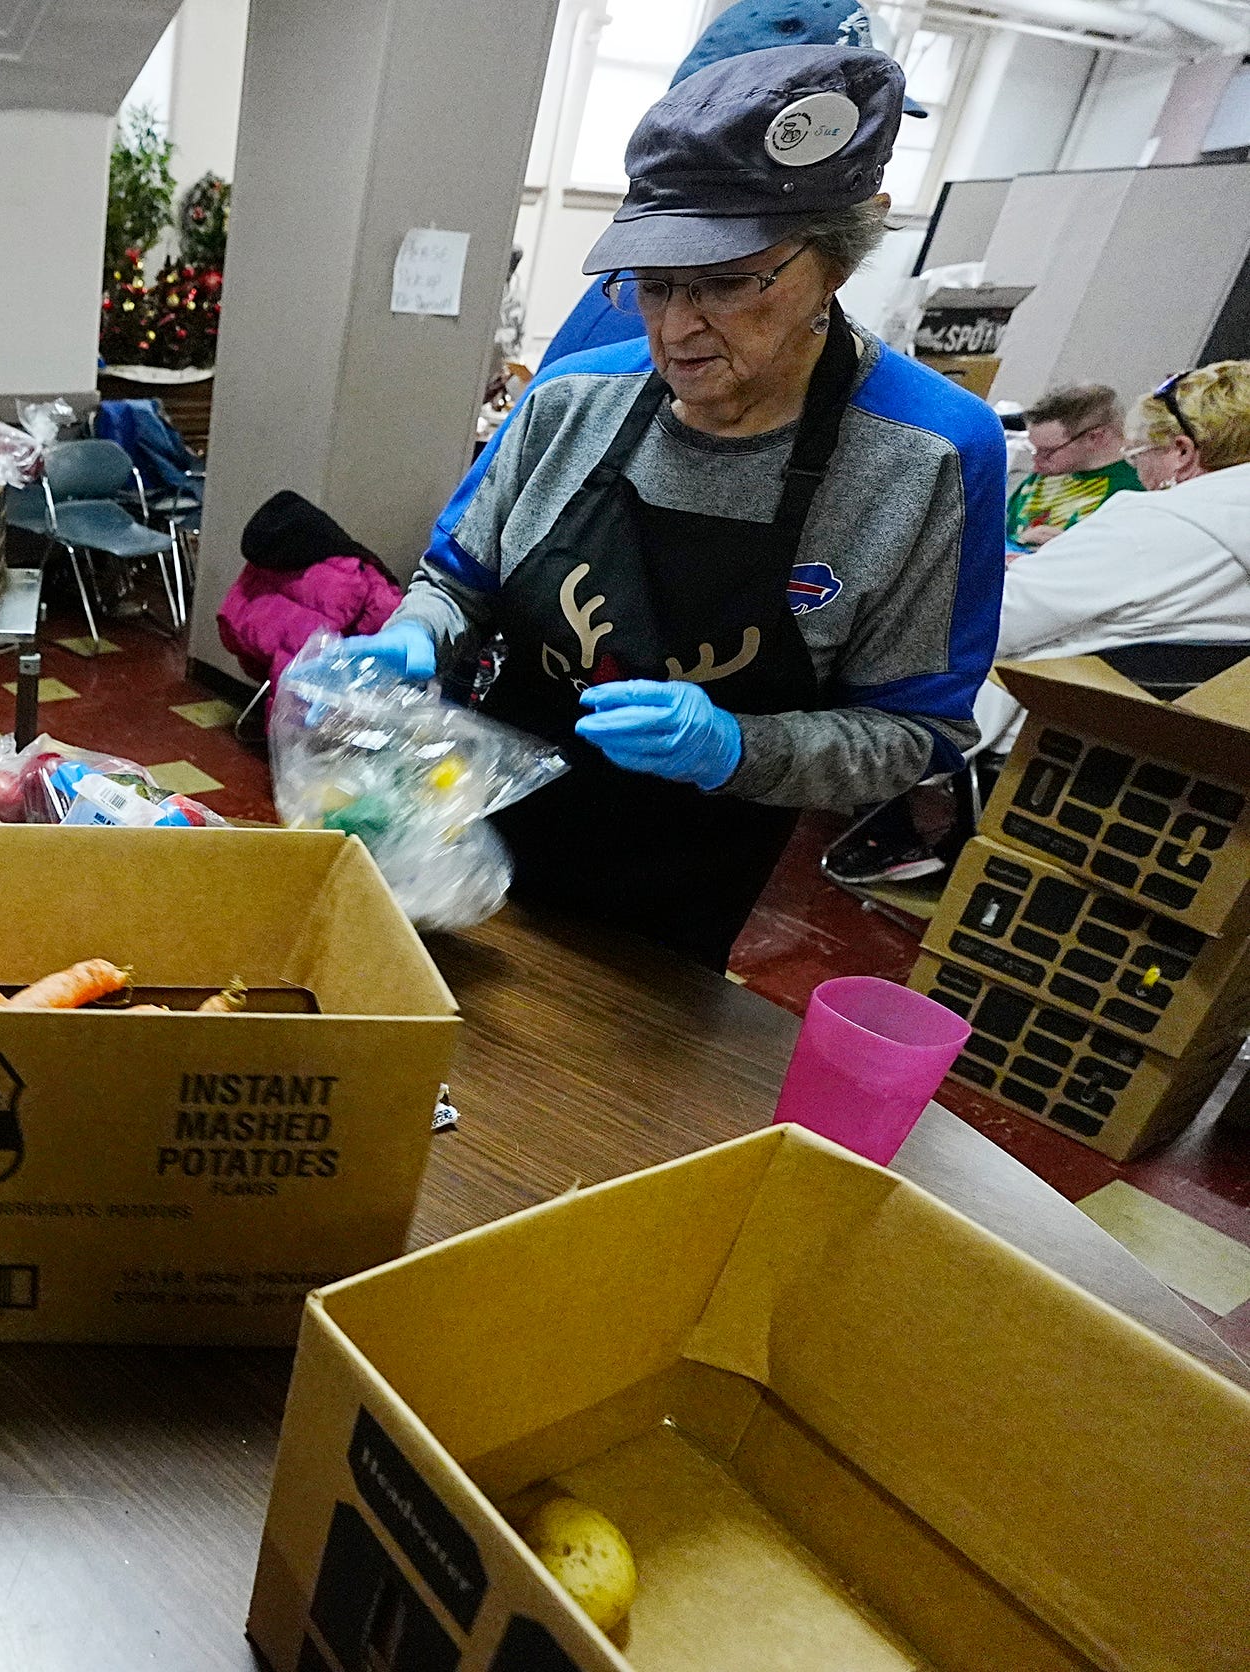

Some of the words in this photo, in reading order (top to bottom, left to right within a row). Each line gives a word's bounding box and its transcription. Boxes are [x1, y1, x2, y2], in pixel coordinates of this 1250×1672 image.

[179, 1073, 340, 1106] INSTANT
[174, 1111, 332, 1143] MASHED
[155, 1147, 340, 1178] POTATOES
